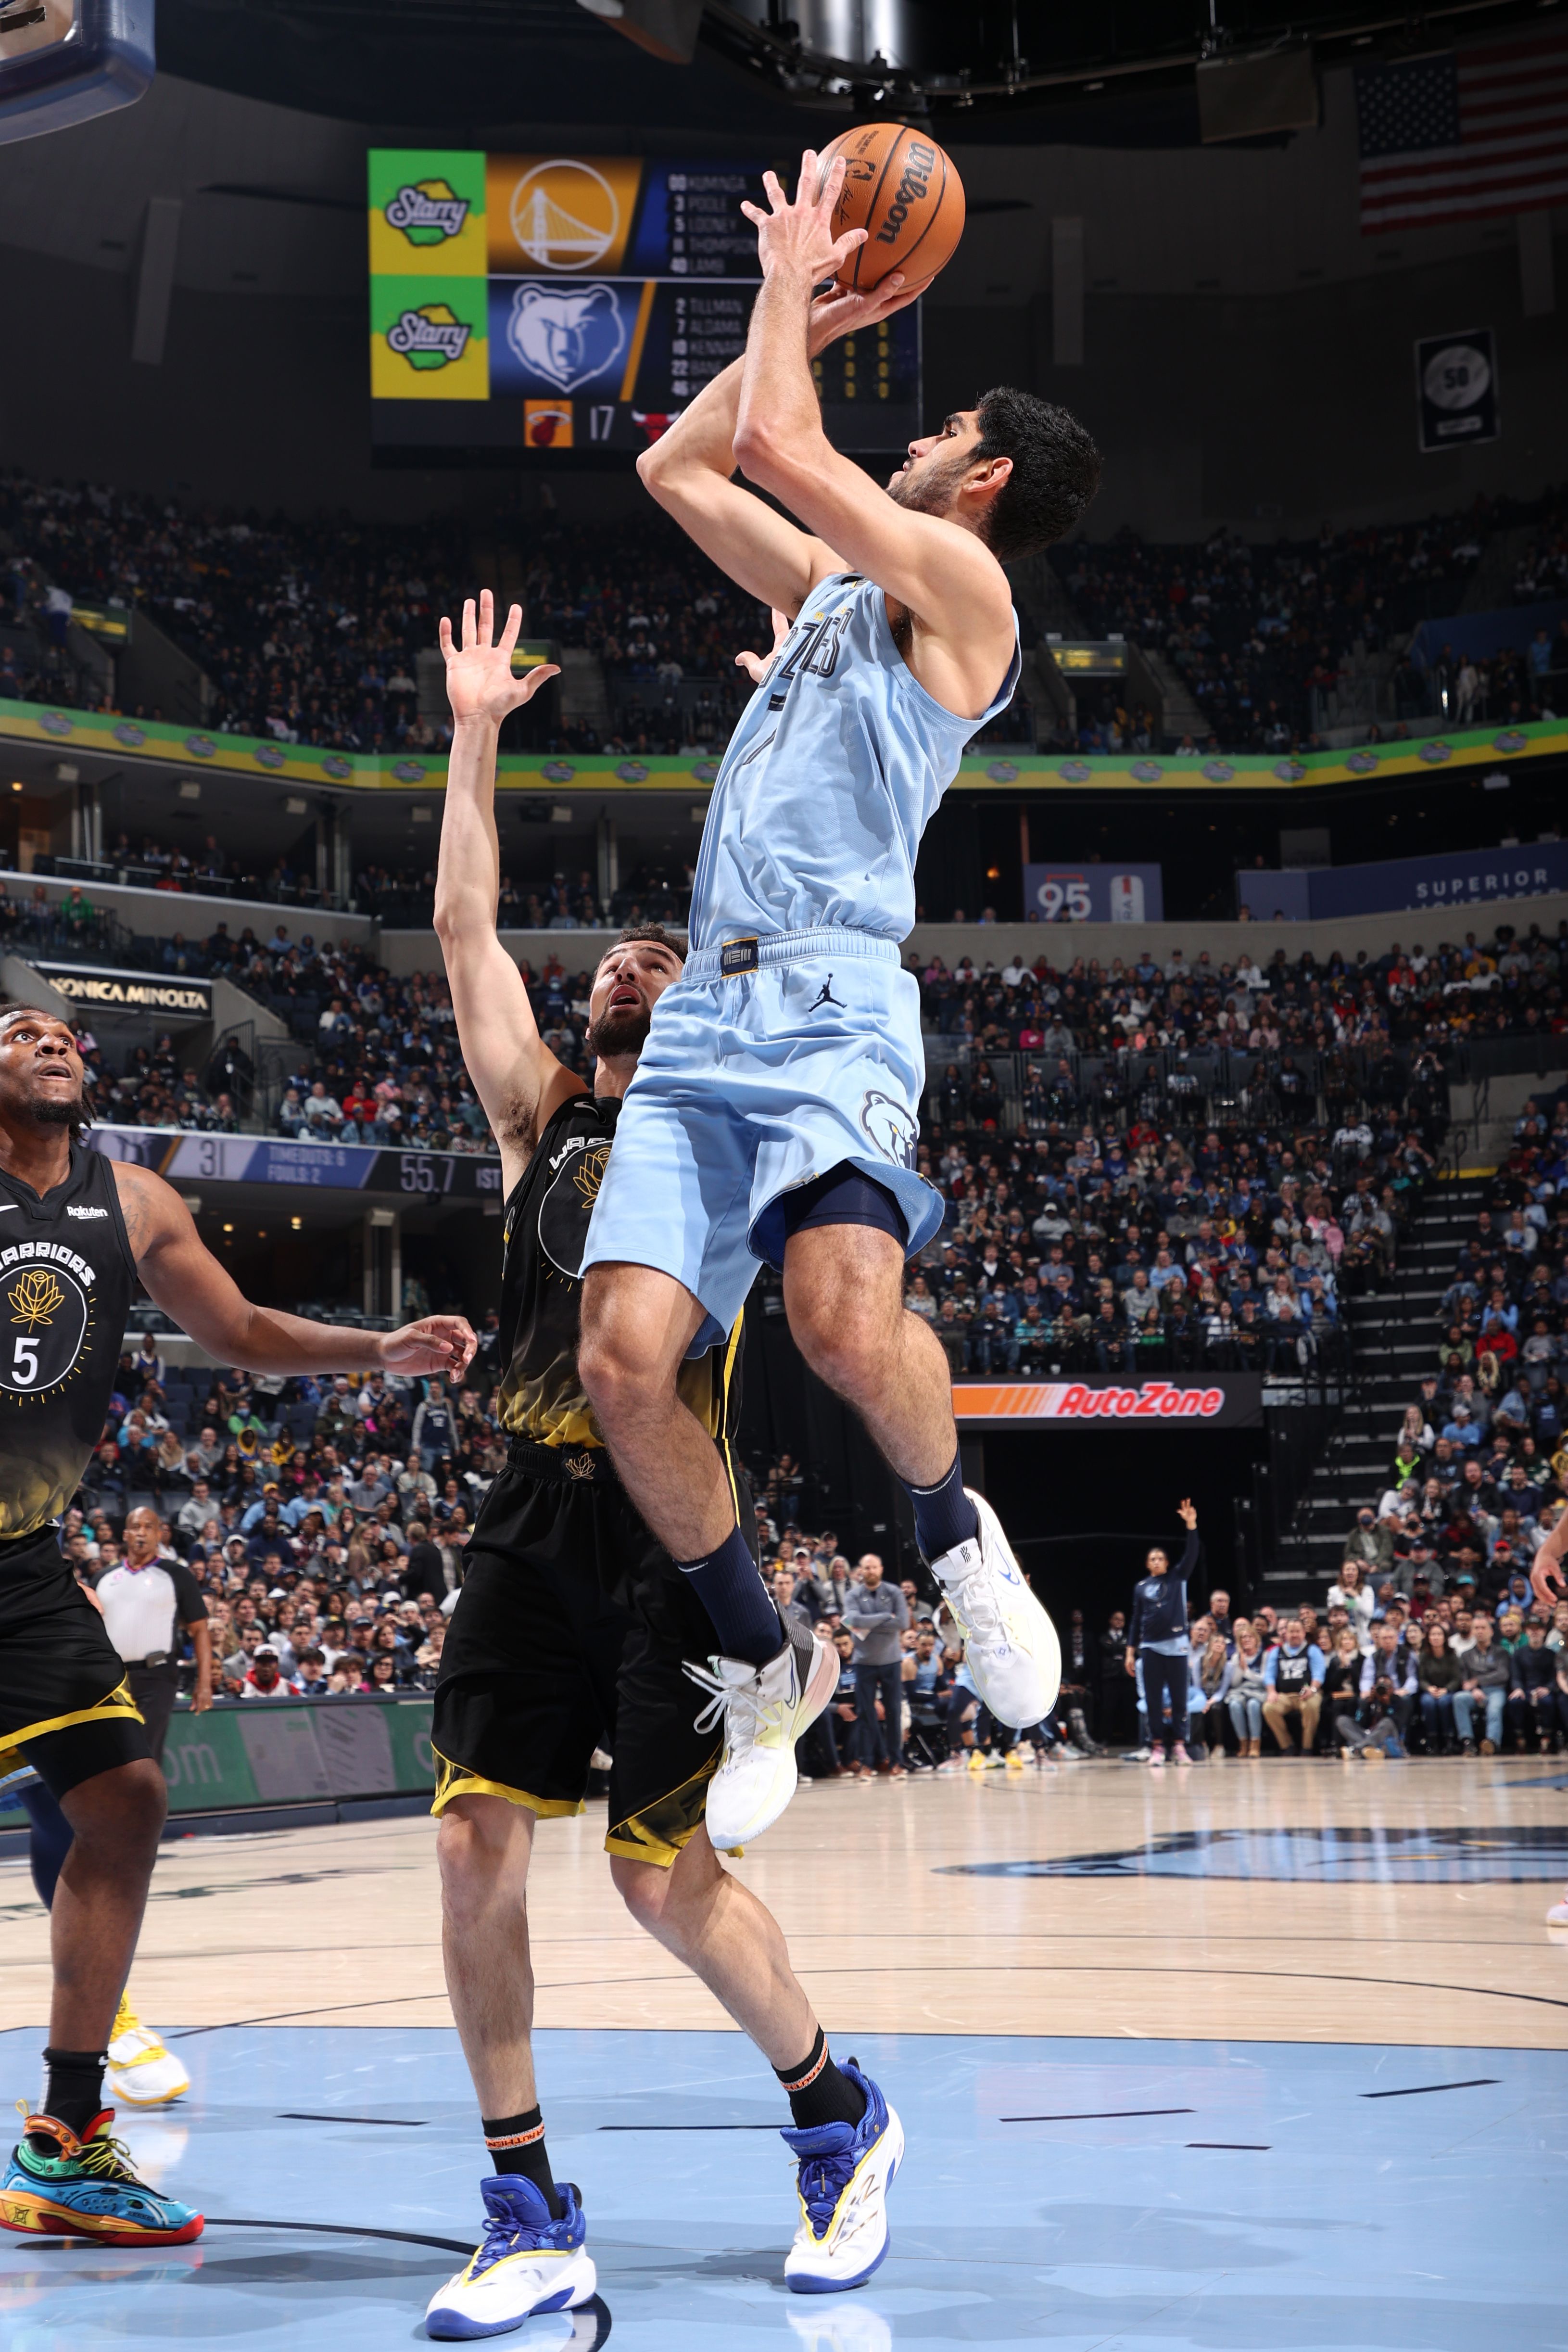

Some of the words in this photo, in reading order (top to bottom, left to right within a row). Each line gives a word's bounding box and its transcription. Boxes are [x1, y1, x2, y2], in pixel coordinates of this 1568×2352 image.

[674, 195, 685, 212] 3
[688, 197, 727, 212] POOLE
[875, 142, 936, 244] Wilson
[386, 186, 470, 236] Starry
[674, 215, 685, 233] 5
[676, 297, 686, 315] 2
[690, 297, 743, 315] TILLMAN
[388, 311, 471, 360] Starry
[677, 318, 686, 334] 7
[590, 406, 615, 441] 17
[1037, 882, 1092, 920] 95
[1416, 868, 1548, 899] SUPERIOR
[126, 985, 208, 1010] MINOLTA
[198, 1139, 225, 1178] 31
[400, 1154, 455, 1193] 55.7
[66, 1206, 109, 1217] Rakuten
[0, 1242, 96, 1287] ARRIORS
[11, 1337, 41, 1385] 5
[1056, 1384, 1223, 1416] AutoZone
